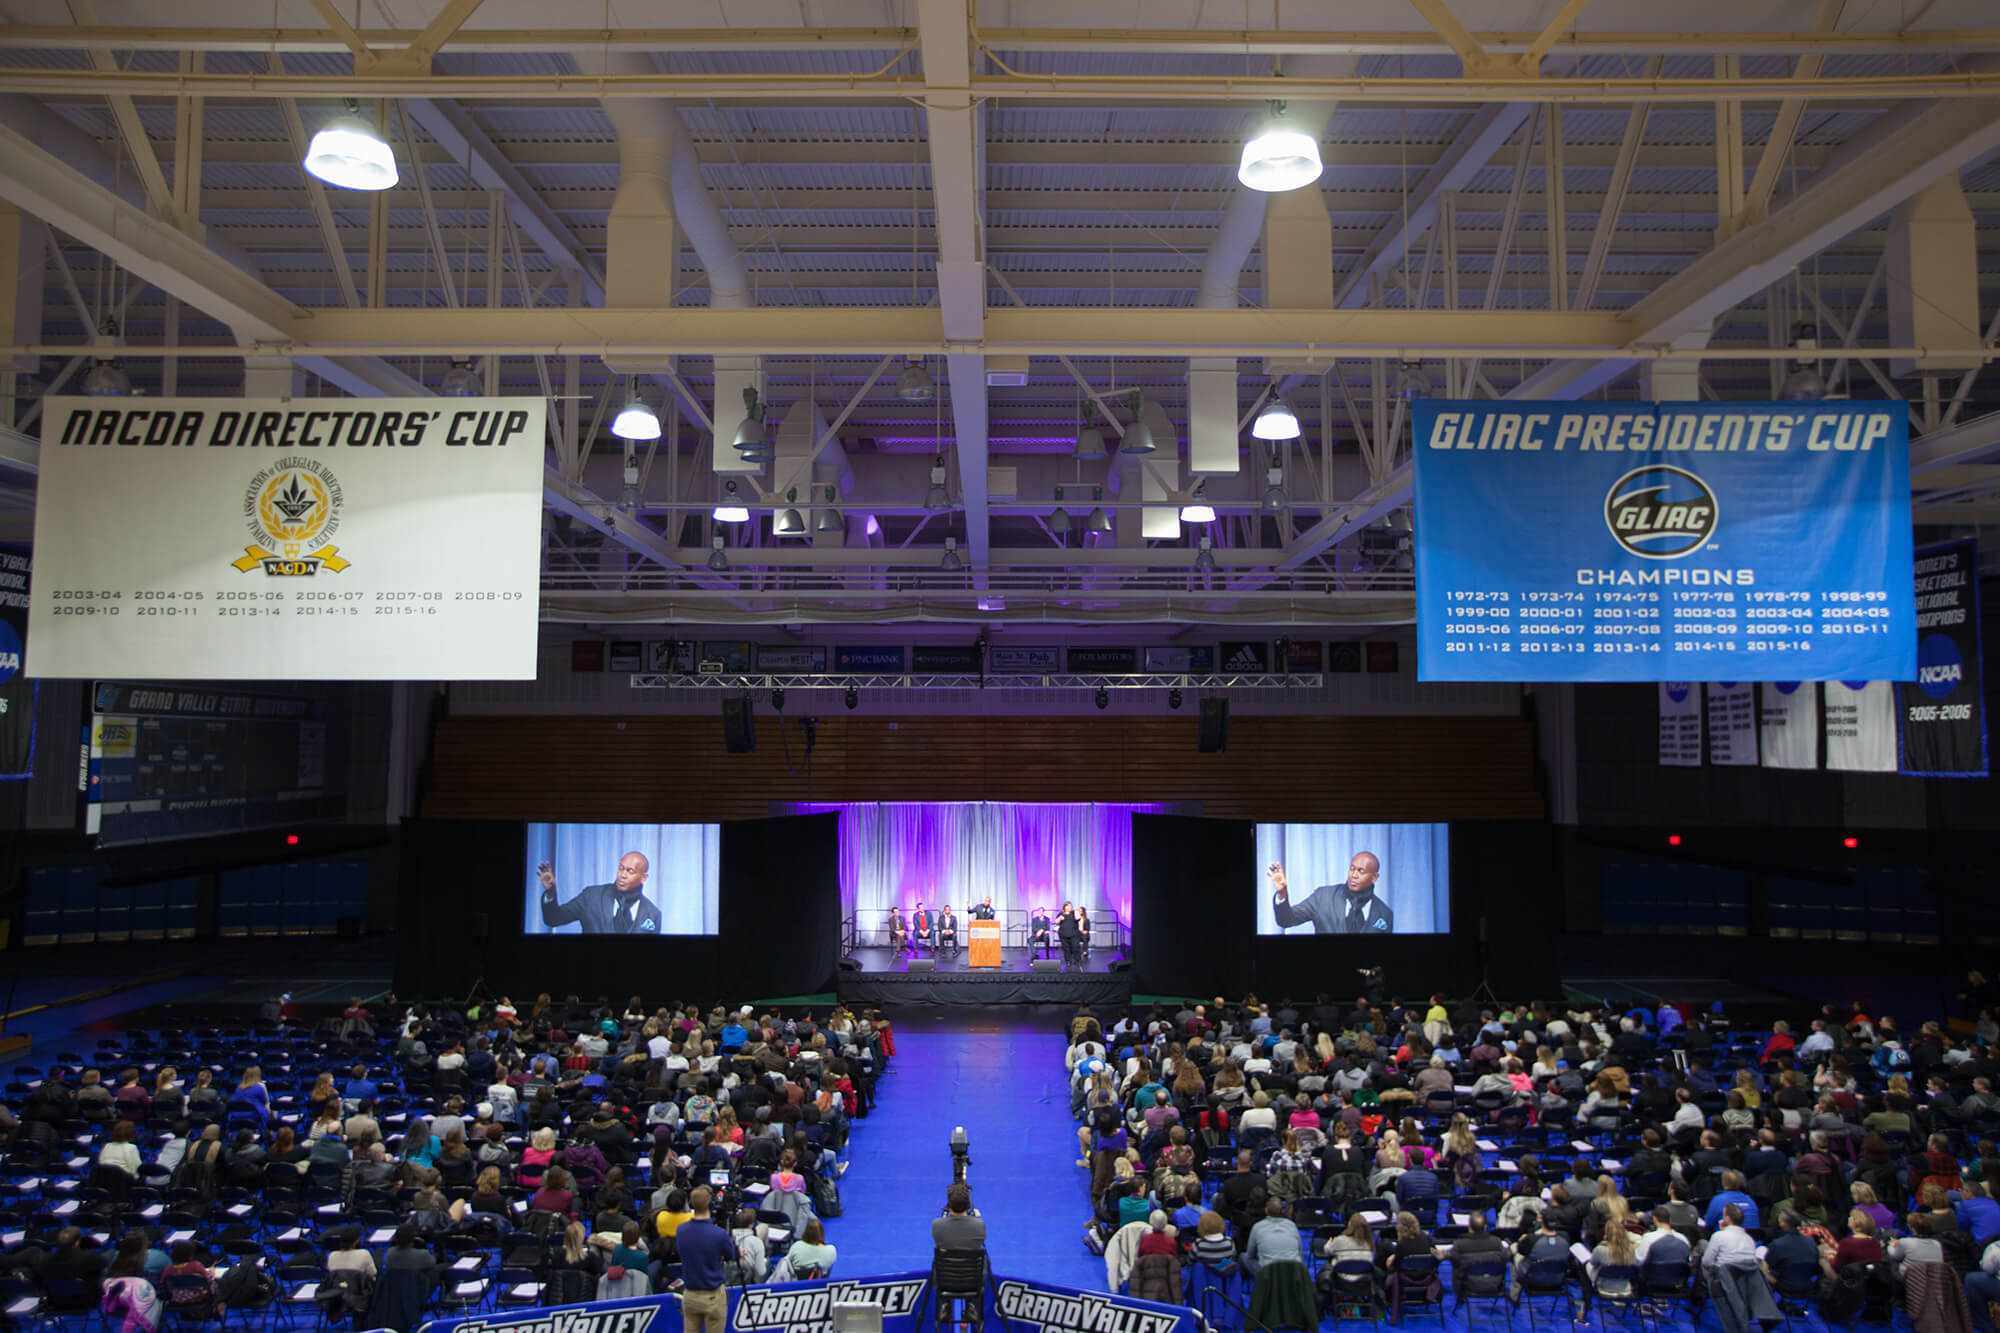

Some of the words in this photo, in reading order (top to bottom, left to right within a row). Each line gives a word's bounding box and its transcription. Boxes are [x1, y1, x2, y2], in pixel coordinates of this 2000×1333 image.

[61, 410, 204, 446] NACDA
[208, 410, 439, 447] DIRECTORS'
[446, 411, 529, 447] CUP
[1430, 413, 1550, 451] GLIAC
[1555, 413, 1804, 452] PRESIDENTS'
[1807, 413, 1891, 451] CUP
[274, 456, 322, 474] COLLEGIATE
[244, 469, 271, 517] ASSOCIATION
[319, 468, 344, 509] DIRECTORS
[1615, 505, 1710, 531] GLIAC
[247, 519, 277, 551] NATIONAL
[308, 516, 340, 550] ATHLETICS
[268, 561, 316, 576] NACDA
[1914, 553, 1958, 574] OMEN'S
[1577, 568, 1755, 586] CHAMPIONS
[1915, 570, 1968, 592] SKETBALL
[53, 591, 121, 600] 2003-04
[134, 591, 204, 600] 2004-05
[216, 591, 284, 600] 2005-06
[296, 592, 364, 600] 2006-07
[376, 592, 443, 600] 2007-08
[455, 592, 523, 600] 2008-09
[1446, 592, 1509, 601] 1972-73
[1521, 592, 1585, 602] 1973-74
[1595, 592, 1659, 602] 1974-75
[1673, 592, 1734, 602] 1977-78
[1746, 592, 1811, 601] 1978-79
[1821, 592, 1887, 601] 1998-99
[1915, 590, 1960, 610] ATIONAL
[53, 607, 120, 615] 2009-10
[137, 607, 197, 615] 2010-11
[218, 607, 281, 616] 2013-14
[296, 607, 358, 616] 2014-15
[375, 606, 437, 615] 2015-16
[1447, 608, 1510, 617] 1999-00
[1520, 608, 1583, 617] 2000-01
[1594, 608, 1659, 618] 2001-02
[1673, 608, 1737, 618] 2002-03
[1746, 608, 1813, 618] 2003-04
[1821, 608, 1889, 618] 2004-05
[1916, 608, 1967, 629] AMPIONS
[1446, 624, 1511, 634] 2005-06
[1520, 624, 1585, 634] 2006-07
[1594, 625, 1660, 635] 2007-08
[1674, 624, 1738, 634] 2008-09
[1746, 624, 1813, 634] 2009-10
[1822, 624, 1888, 634] 2010-11
[1446, 642, 1511, 652] 2011-12
[1520, 643, 1585, 652] 2012-13
[1593, 643, 1660, 653] 2013-14
[1674, 642, 1736, 651] 2014-15
[1747, 642, 1811, 651] 2015-16
[1224, 661, 1265, 672] adidas
[1919, 664, 1963, 684] NCAA
[128, 689, 175, 710] GRAND
[177, 692, 218, 712] VALLEY
[1909, 704, 1972, 722] 2005-2006
